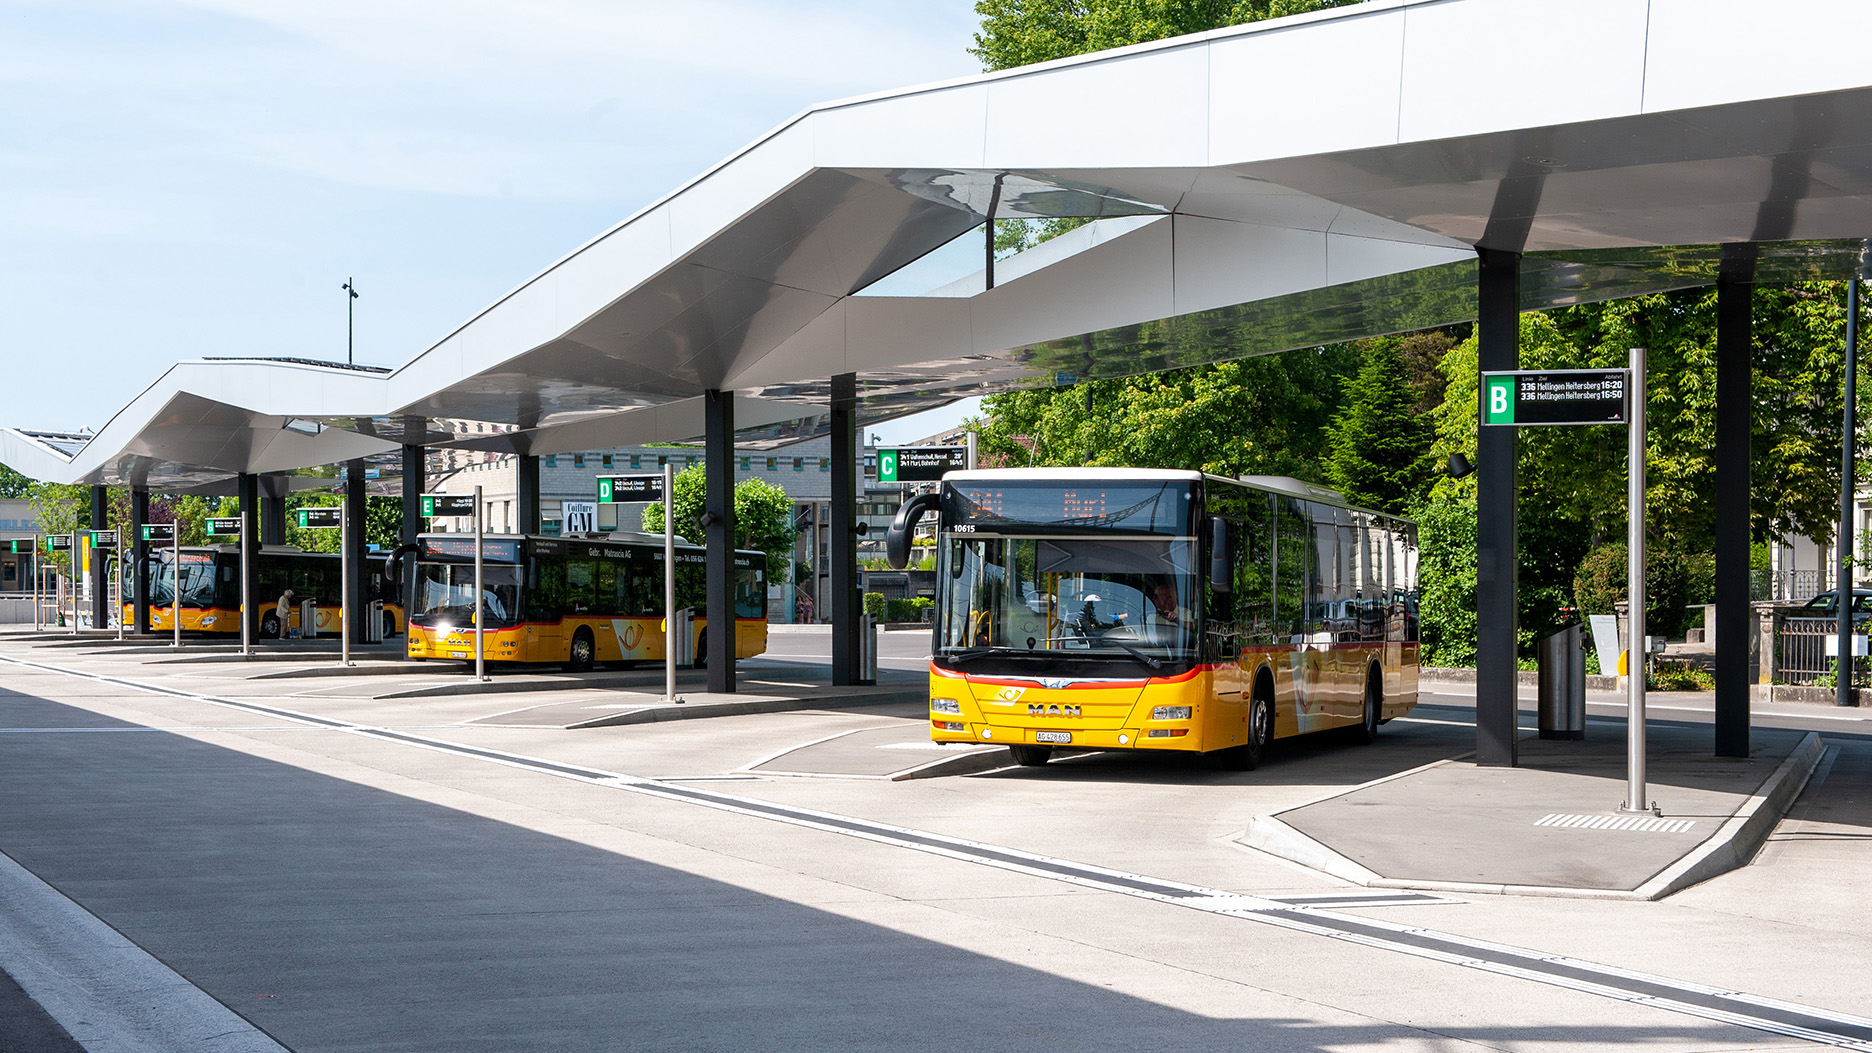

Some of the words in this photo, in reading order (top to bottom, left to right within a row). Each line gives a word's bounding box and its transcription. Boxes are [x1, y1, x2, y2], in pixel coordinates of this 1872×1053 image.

[1521, 383, 1536, 391] 336
[1601, 381, 1622, 389] 16:20
[1491, 386, 1507, 413] B
[1521, 392, 1536, 400] 336
[1601, 390, 1622, 398] 16:50
[882, 456, 892, 475] C
[600, 483, 609, 497] D
[424, 501, 430, 512] E
[568, 503, 592, 512] Coiffure
[300, 514, 305, 524] F
[144, 528, 149, 537] H
[208, 523, 213, 532] G
[588, 547, 601, 556] Gebr.
[604, 549, 624, 558] Matrascia
[625, 550, 631, 559] AG
[1028, 704, 1080, 715] MAN
